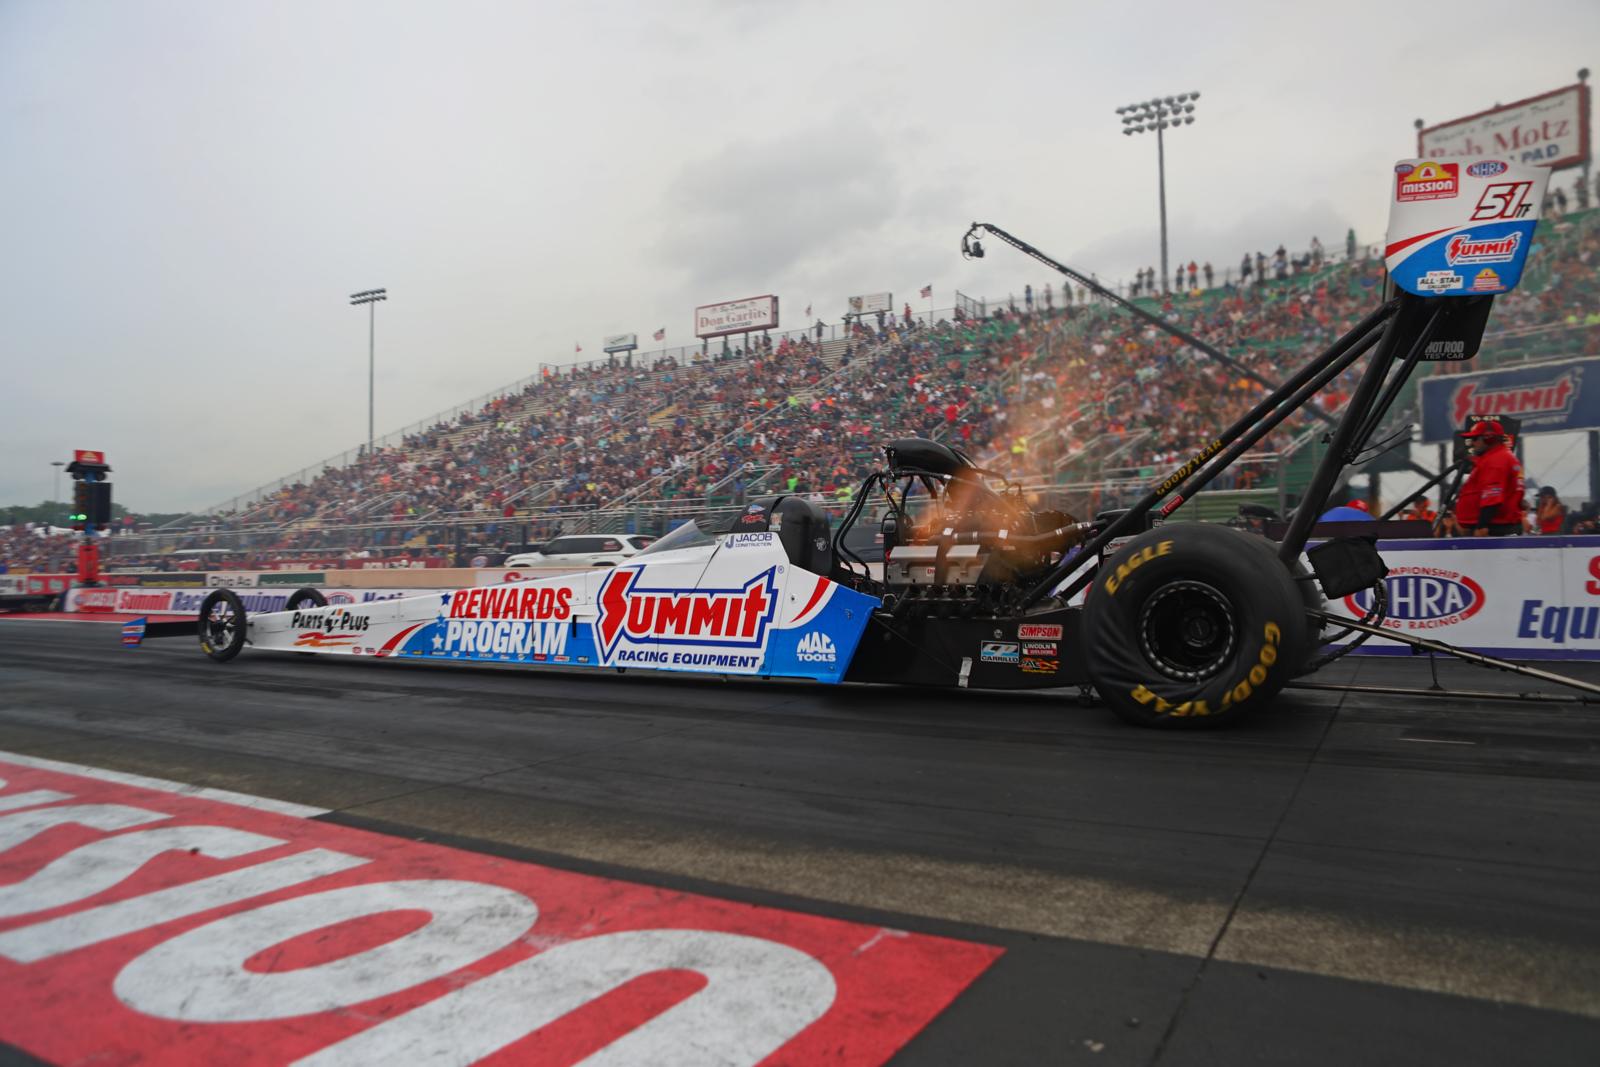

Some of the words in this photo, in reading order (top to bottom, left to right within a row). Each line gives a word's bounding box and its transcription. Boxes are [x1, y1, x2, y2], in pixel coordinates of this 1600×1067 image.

[1494, 119, 1570, 151] Motz
[1521, 144, 1560, 164] PAD
[1470, 162, 1505, 176] NHRA
[1469, 181, 1534, 221] 51
[1515, 203, 1533, 218] TF
[1444, 341, 1464, 353] ROD
[736, 533, 772, 543] JACOB
[1105, 540, 1175, 595] EAGLE
[1388, 566, 1460, 580] MPIONSHIP
[450, 587, 573, 620] REWARDS
[291, 611, 323, 629] PARTS
[340, 612, 370, 631] PLUS
[1408, 615, 1460, 630] RACING
[1517, 600, 1600, 643] Equ
[445, 621, 569, 656] PROGRAM
[1020, 626, 1061, 637] SIMPSON
[797, 632, 836, 654] MAC
[617, 650, 669, 664] RACING
[672, 652, 760, 669] EQUIPMENT
[796, 653, 836, 662] TOOLS
